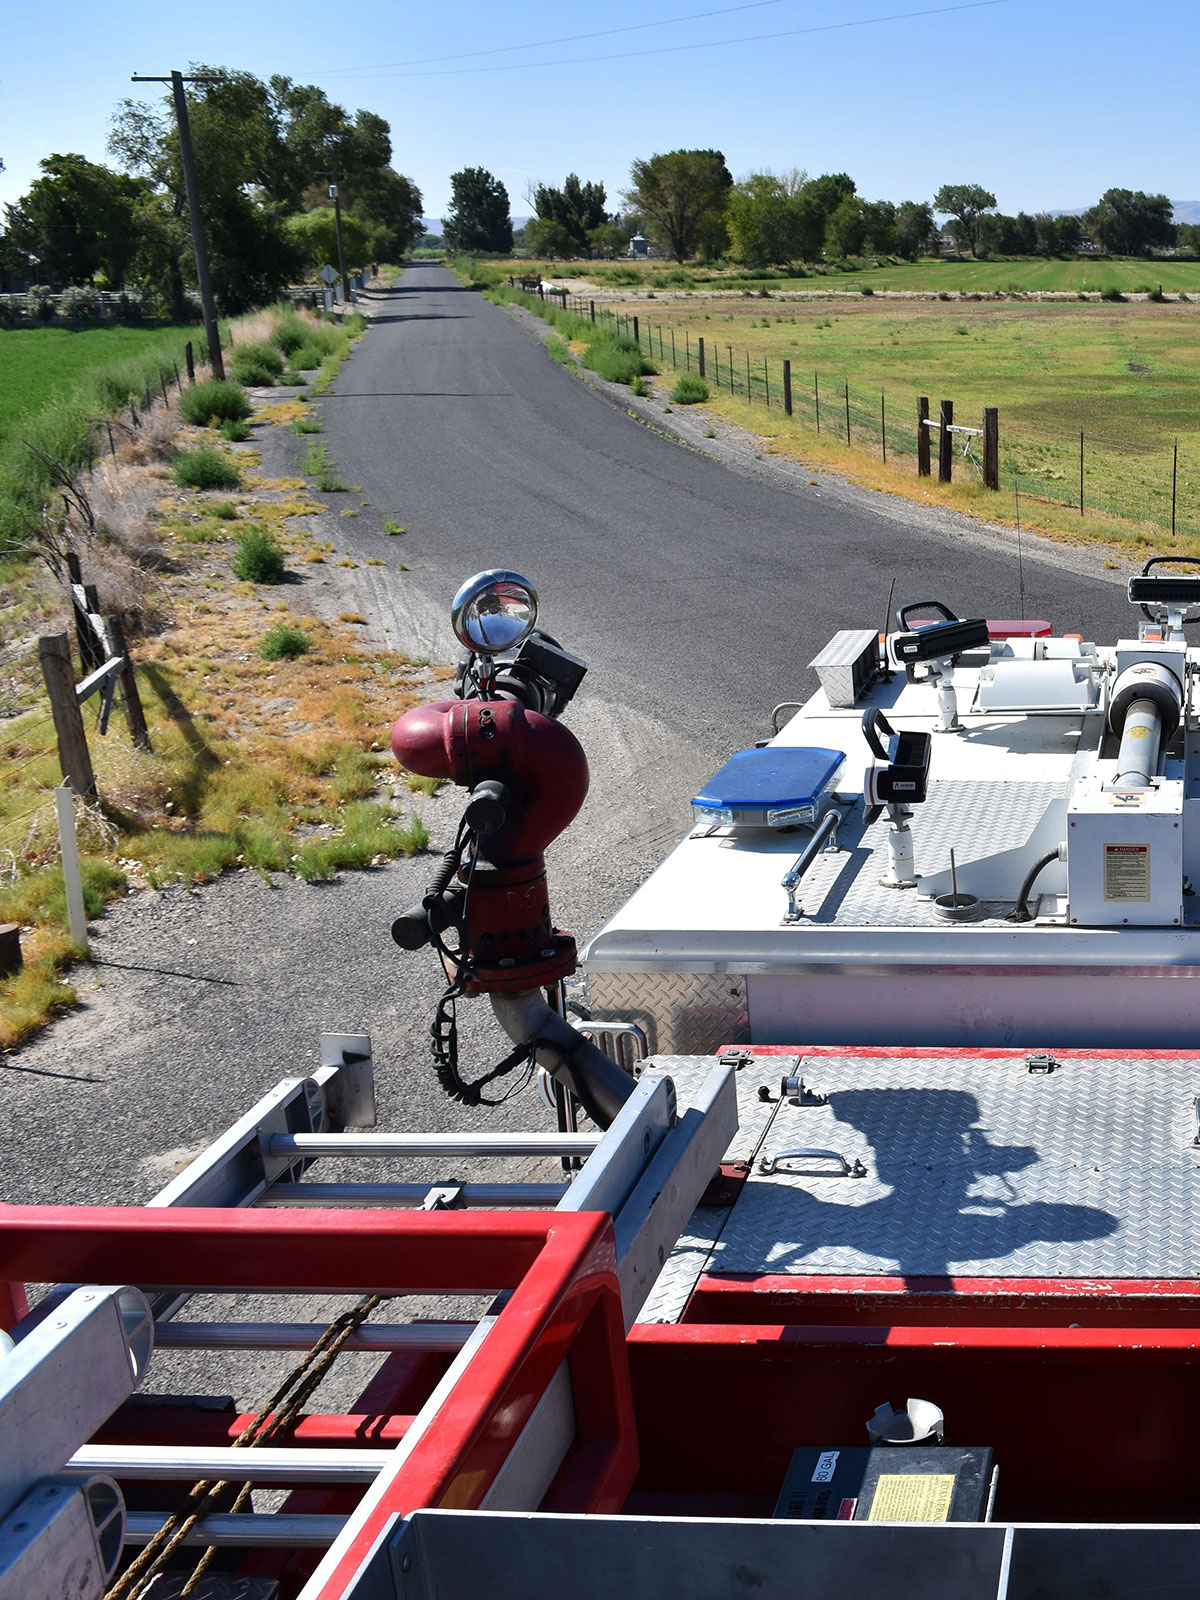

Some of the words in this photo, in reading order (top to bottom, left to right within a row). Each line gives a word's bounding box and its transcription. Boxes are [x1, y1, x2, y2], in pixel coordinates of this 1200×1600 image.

[820, 1452, 836, 1470] GAL
[816, 1471, 829, 1481] 60
[937, 1480, 951, 1504] FOAM
